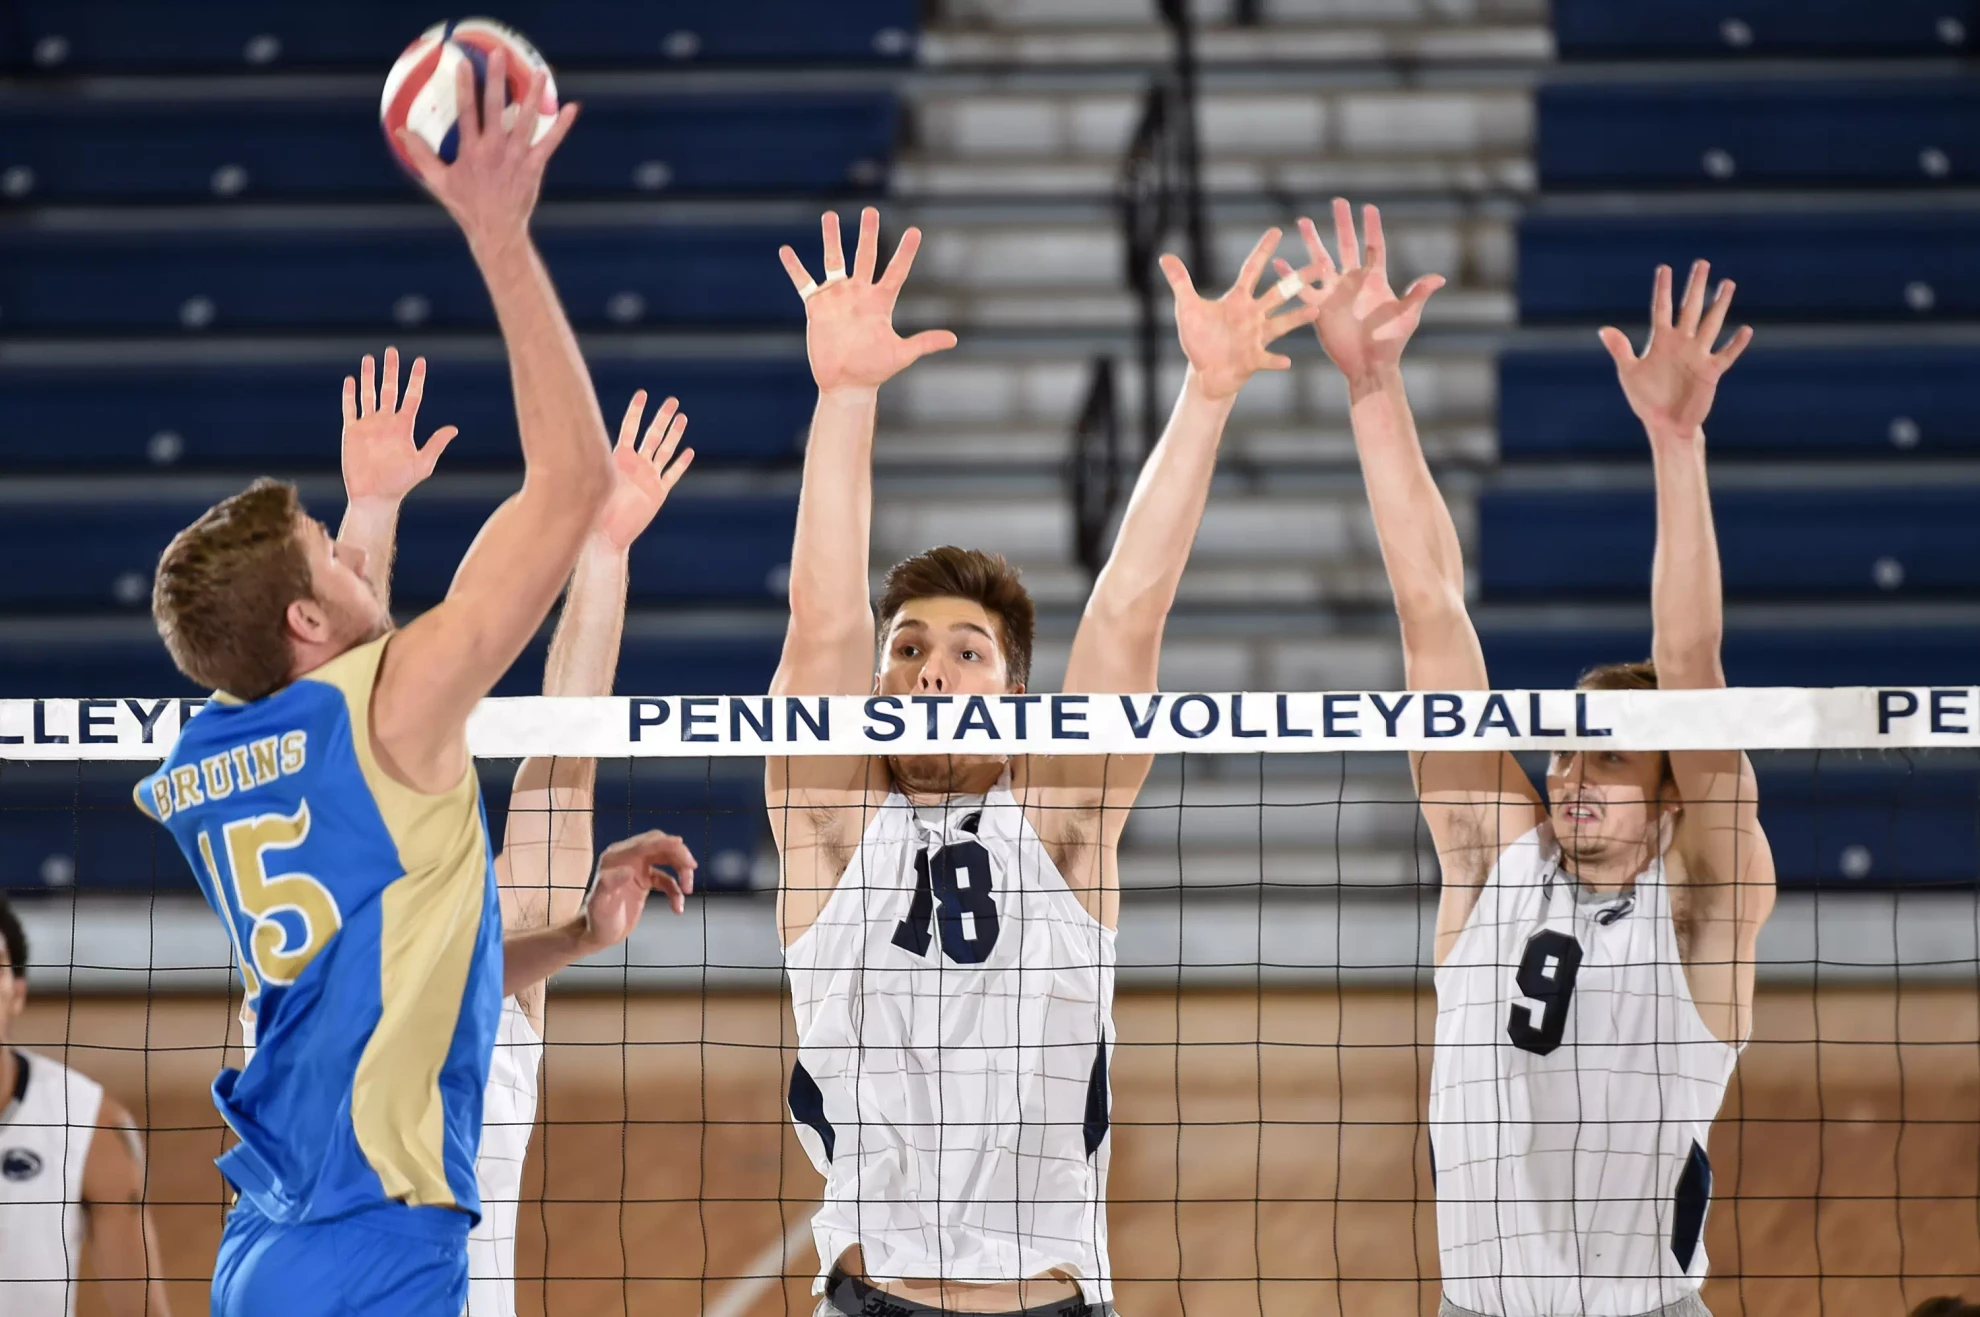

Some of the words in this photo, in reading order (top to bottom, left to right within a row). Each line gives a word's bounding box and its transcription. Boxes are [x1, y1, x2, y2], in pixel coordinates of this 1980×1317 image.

[0, 700, 205, 744] LEY
[629, 696, 831, 742] PENN
[863, 695, 1090, 742] STATE
[1119, 692, 1613, 739] VOLLEYBALL
[152, 729, 307, 821] BRUINS
[198, 797, 342, 999] 15
[891, 840, 1000, 964] 18
[1507, 929, 1584, 1057] 9
